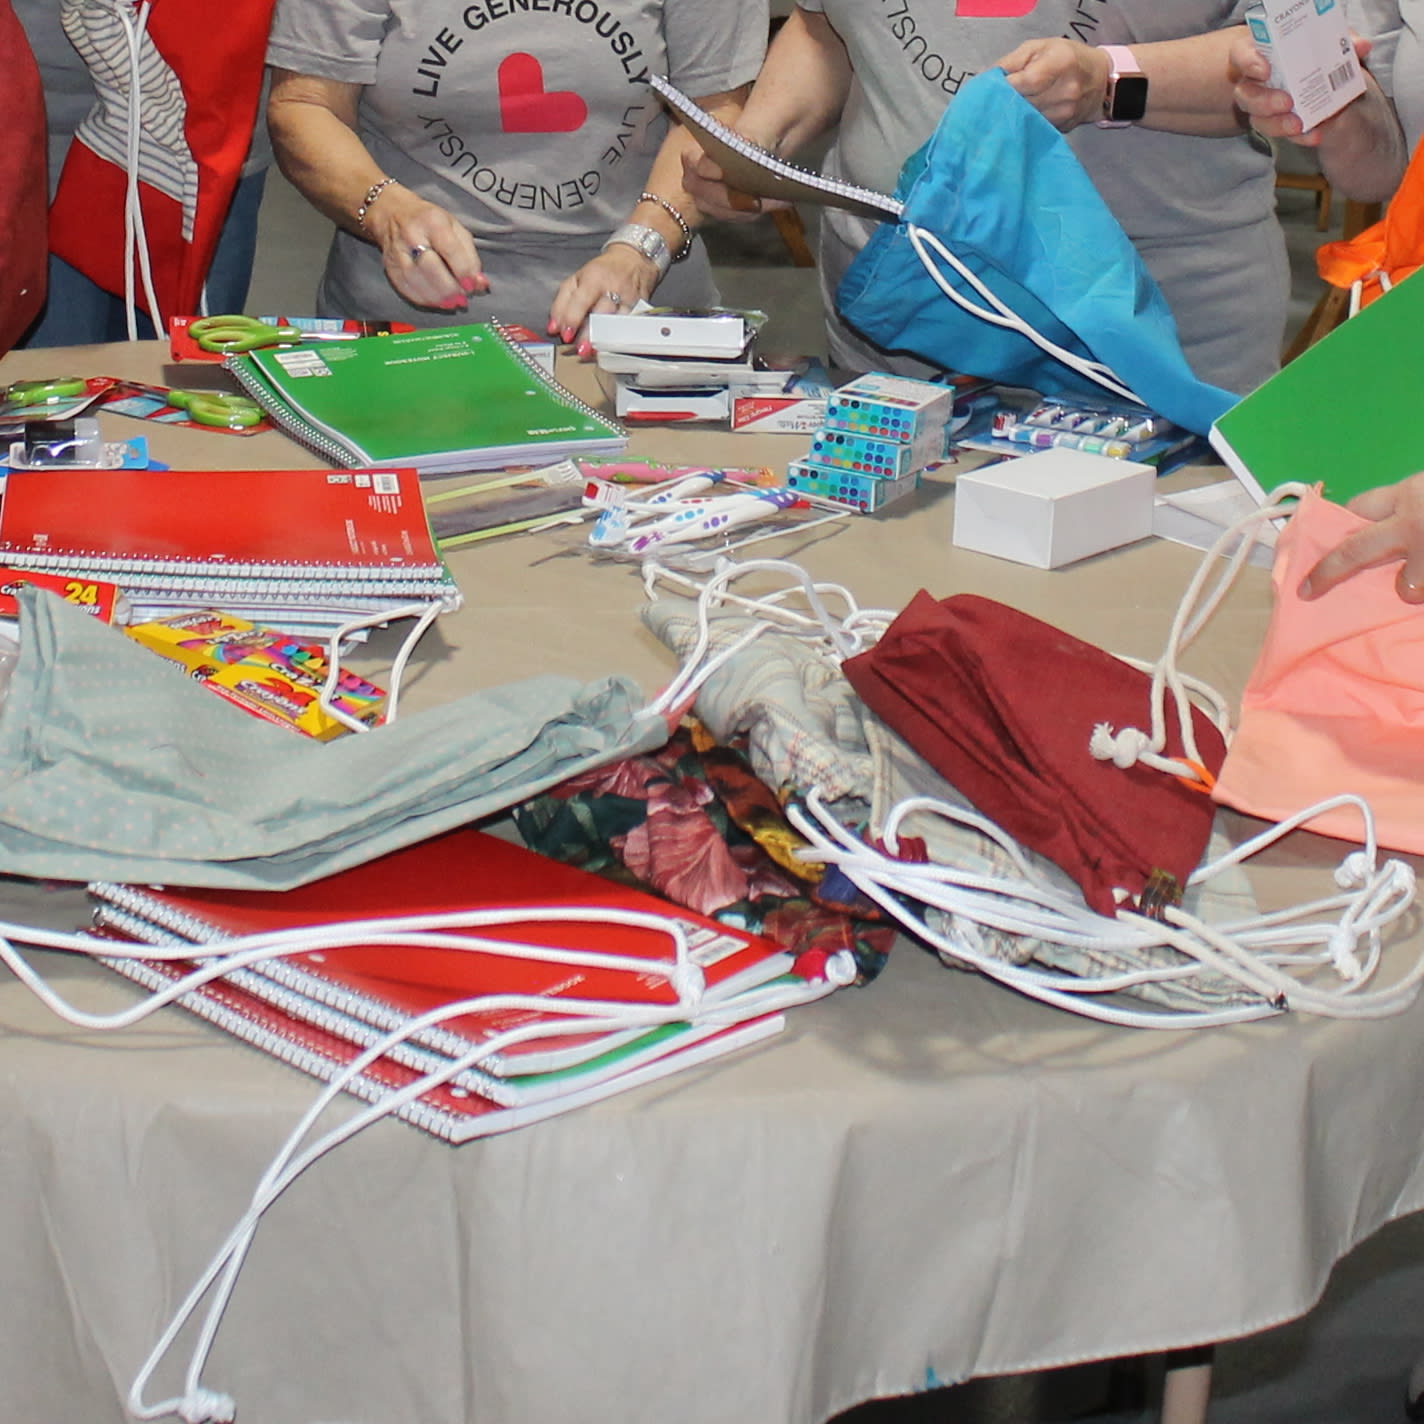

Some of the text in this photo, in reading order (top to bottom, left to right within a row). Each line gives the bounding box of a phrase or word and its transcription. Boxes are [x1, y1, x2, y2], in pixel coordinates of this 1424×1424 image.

[413, 27, 464, 97] LIVE
[417, 113, 602, 211] GENEROUSLY
[602, 106, 645, 166] LIVE
[64, 582, 99, 606] 24
